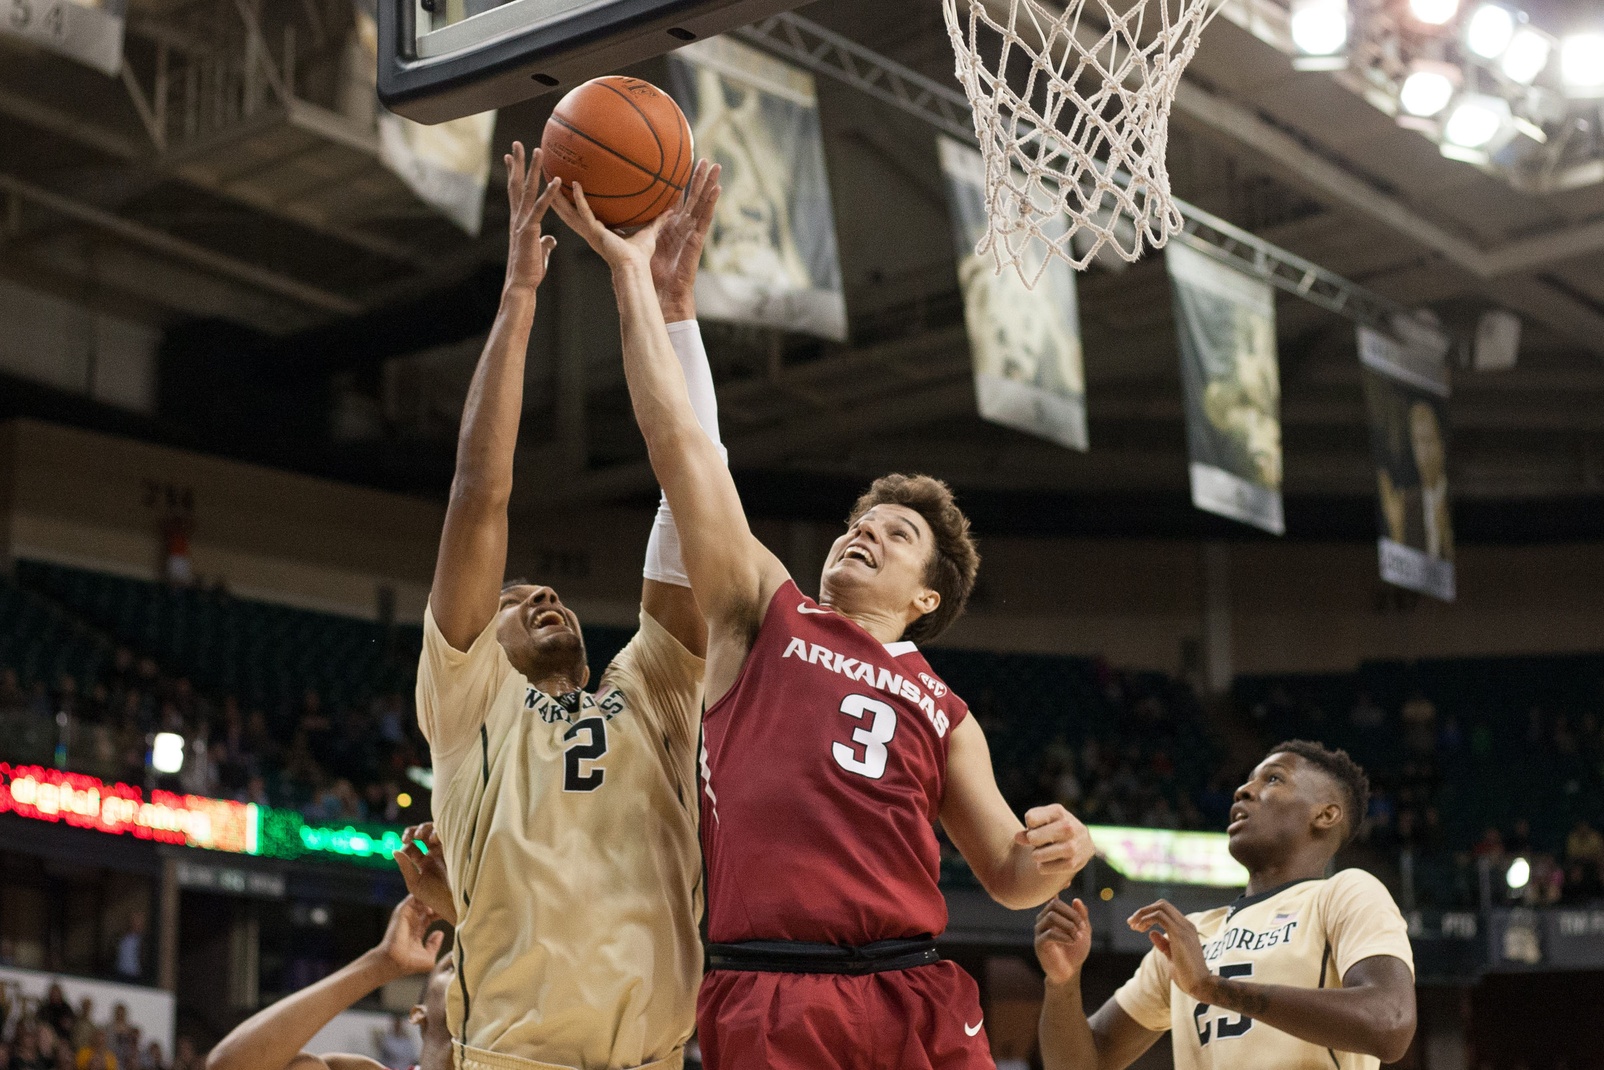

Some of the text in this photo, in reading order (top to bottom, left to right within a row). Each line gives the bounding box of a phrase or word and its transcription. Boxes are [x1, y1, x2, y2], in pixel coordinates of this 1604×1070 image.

[781, 636, 950, 739] ARKANSAS
[562, 716, 609, 793] 2
[832, 693, 898, 780] 3
